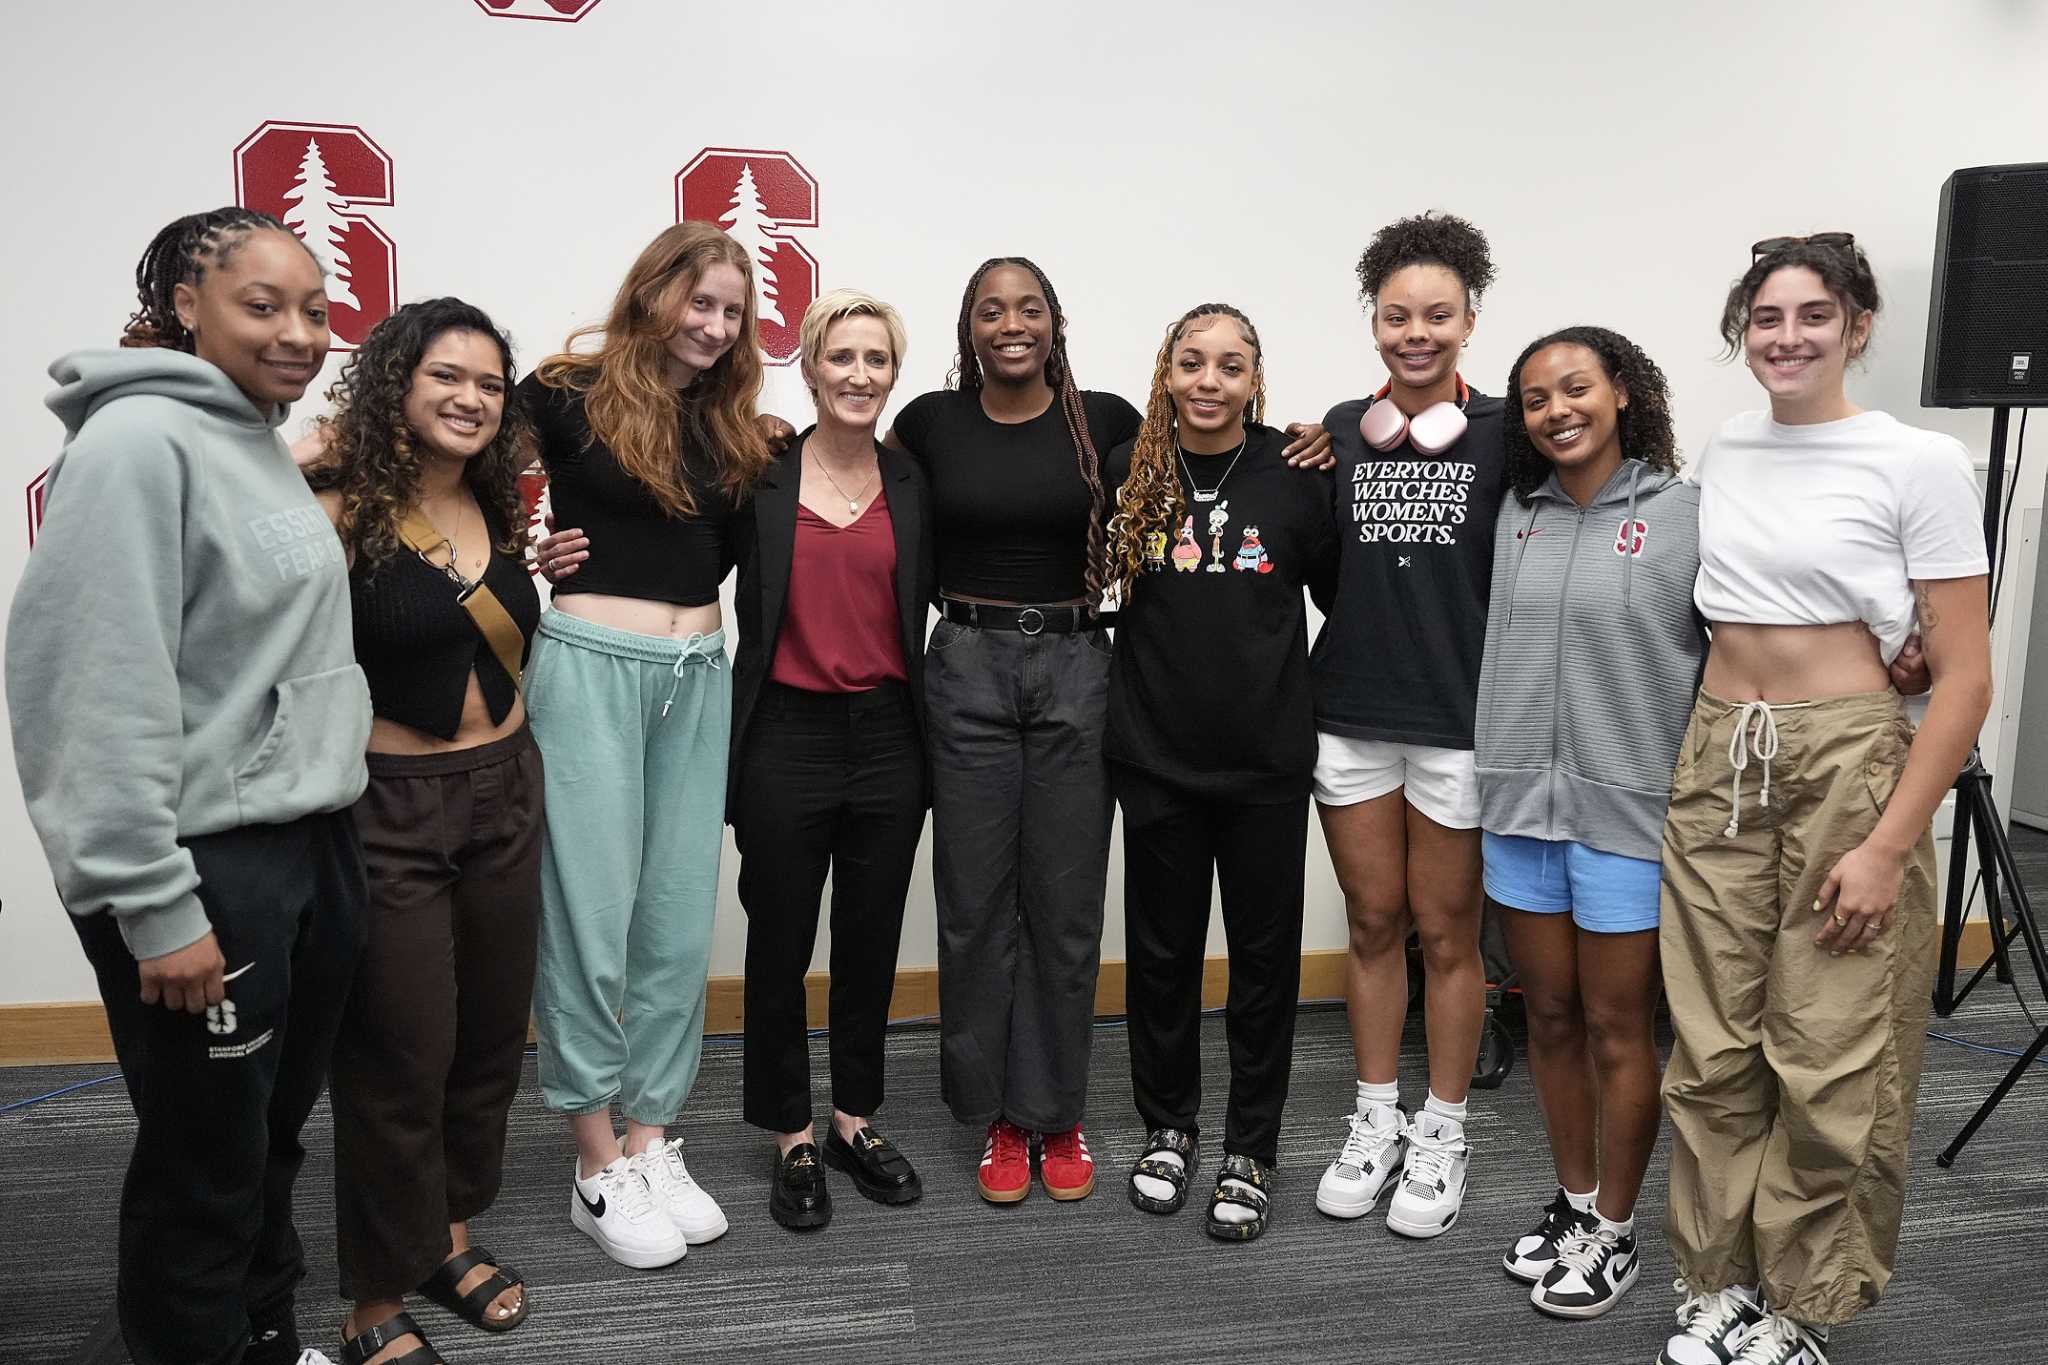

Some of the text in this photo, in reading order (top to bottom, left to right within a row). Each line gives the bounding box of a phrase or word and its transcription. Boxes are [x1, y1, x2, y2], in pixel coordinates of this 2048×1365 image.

[1351, 461, 1477, 482] EVERYONE
[1353, 481, 1469, 503] WATCHES
[1352, 502, 1468, 524] WOMEN'S
[1359, 523, 1456, 545] SPORTS.
